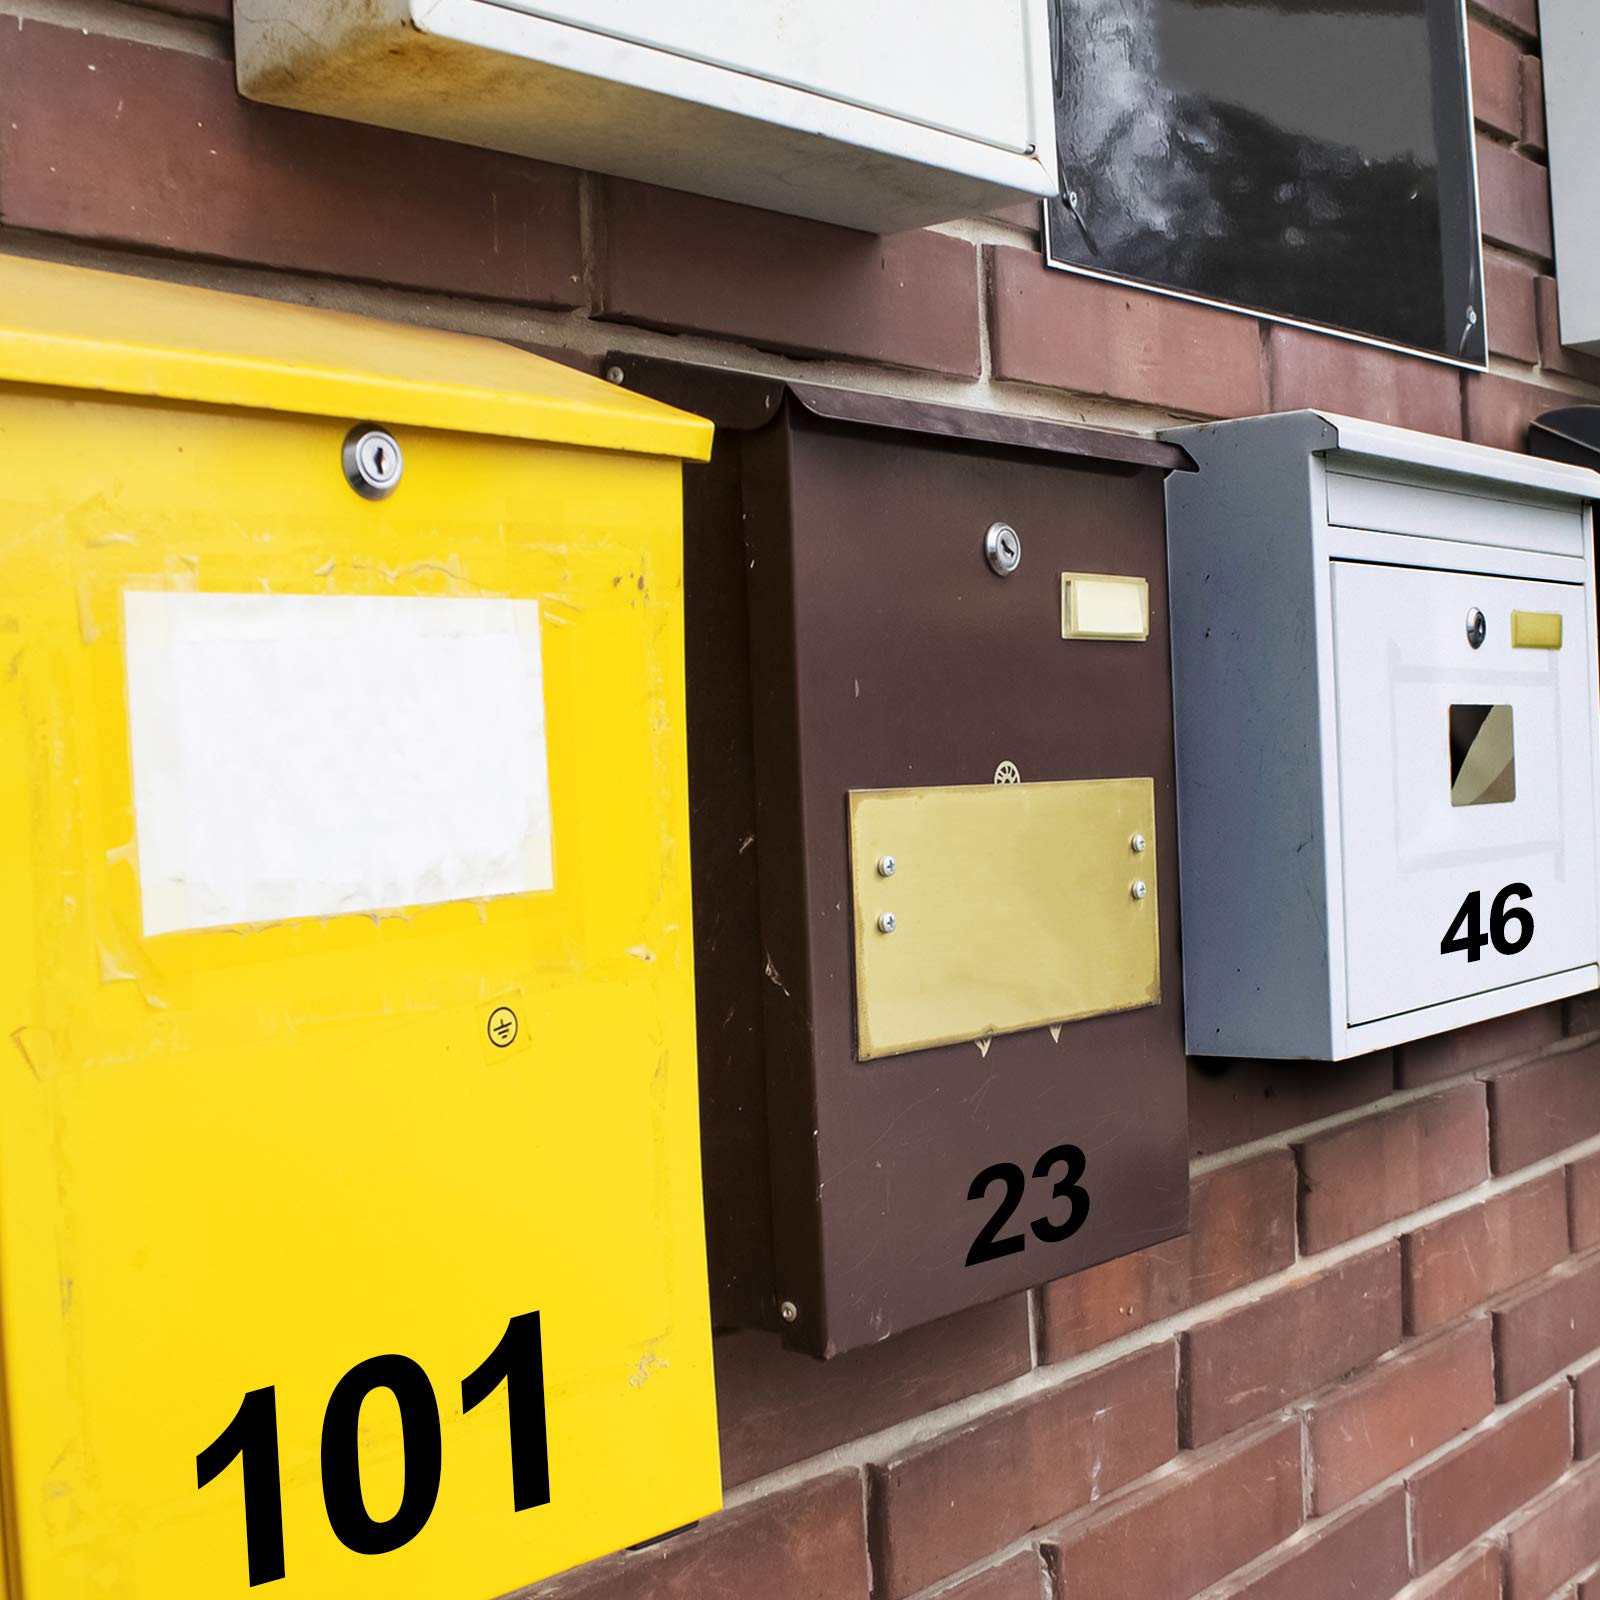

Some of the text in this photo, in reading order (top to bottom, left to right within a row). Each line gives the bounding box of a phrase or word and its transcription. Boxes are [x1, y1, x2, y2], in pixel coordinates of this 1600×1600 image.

[1440, 882, 1535, 963] 46
[964, 1144, 1091, 1268] 23
[196, 1310, 551, 1588] 101
